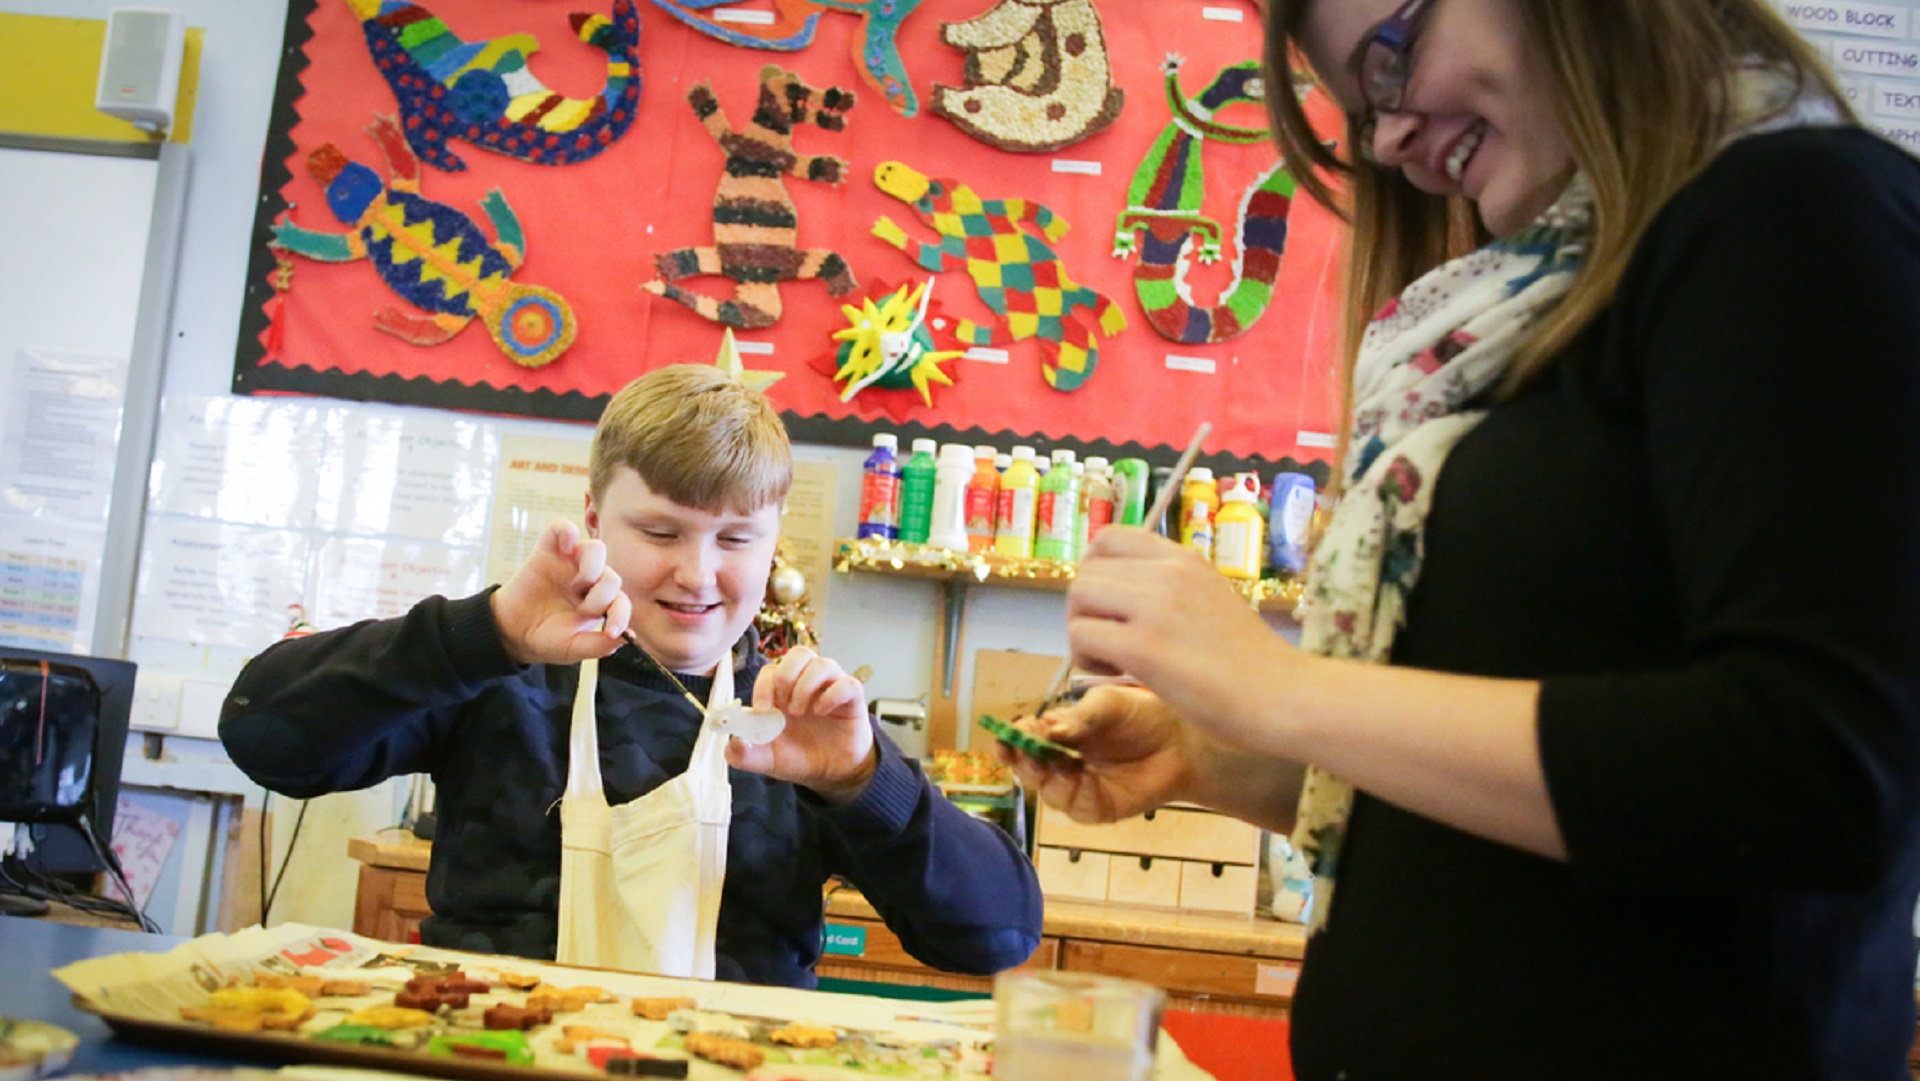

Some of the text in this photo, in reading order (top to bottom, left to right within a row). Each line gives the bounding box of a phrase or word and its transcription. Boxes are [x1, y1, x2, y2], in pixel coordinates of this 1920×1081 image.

[1787, 4, 1896, 27] WOOD BLOCK
[1842, 48, 1918, 68] CUTTING
[510, 459, 530, 470] ART
[534, 461, 558, 473] AND
[835, 934, 858, 945] Card
